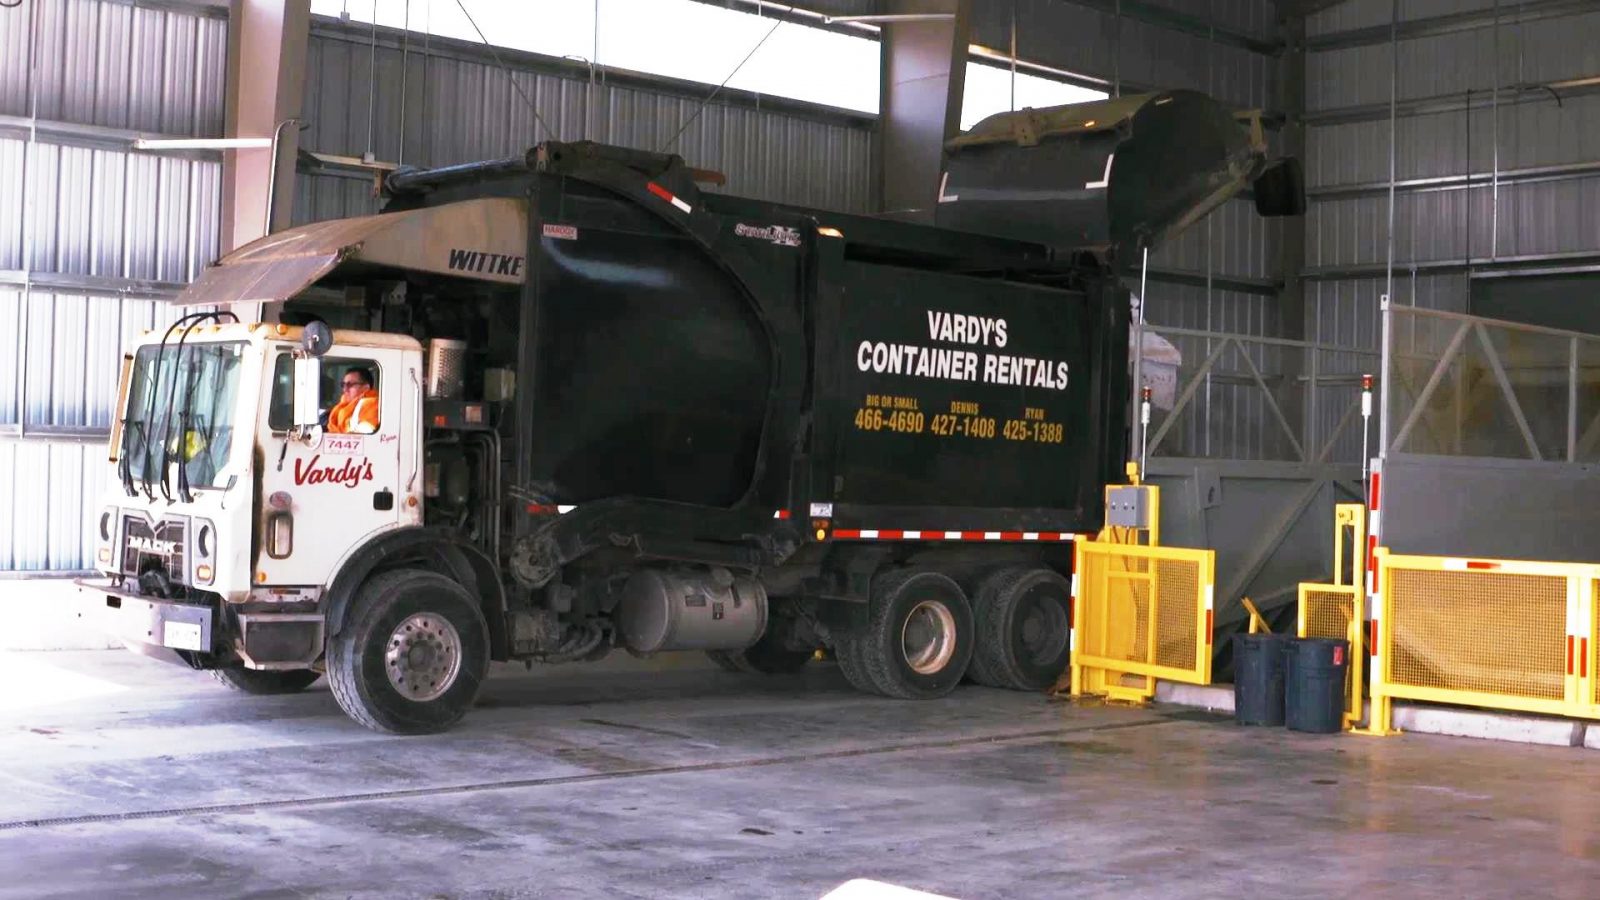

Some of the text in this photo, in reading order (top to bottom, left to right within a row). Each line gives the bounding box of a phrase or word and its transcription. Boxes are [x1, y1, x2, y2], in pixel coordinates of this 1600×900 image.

[448, 249, 525, 276] WITTKE
[927, 310, 1008, 348] VARDY'S
[857, 340, 1069, 390] CONTAINER RENTALS
[866, 395, 919, 410] BIG OR SMALL
[950, 401, 979, 415] DENNIS
[1024, 407, 1045, 420] RYAN
[855, 408, 925, 433] 466-4690
[931, 414, 996, 438] 427-1408
[1002, 419, 1063, 443] 425-1388
[327, 439, 360, 450] 7447
[294, 454, 374, 489] Vardy's
